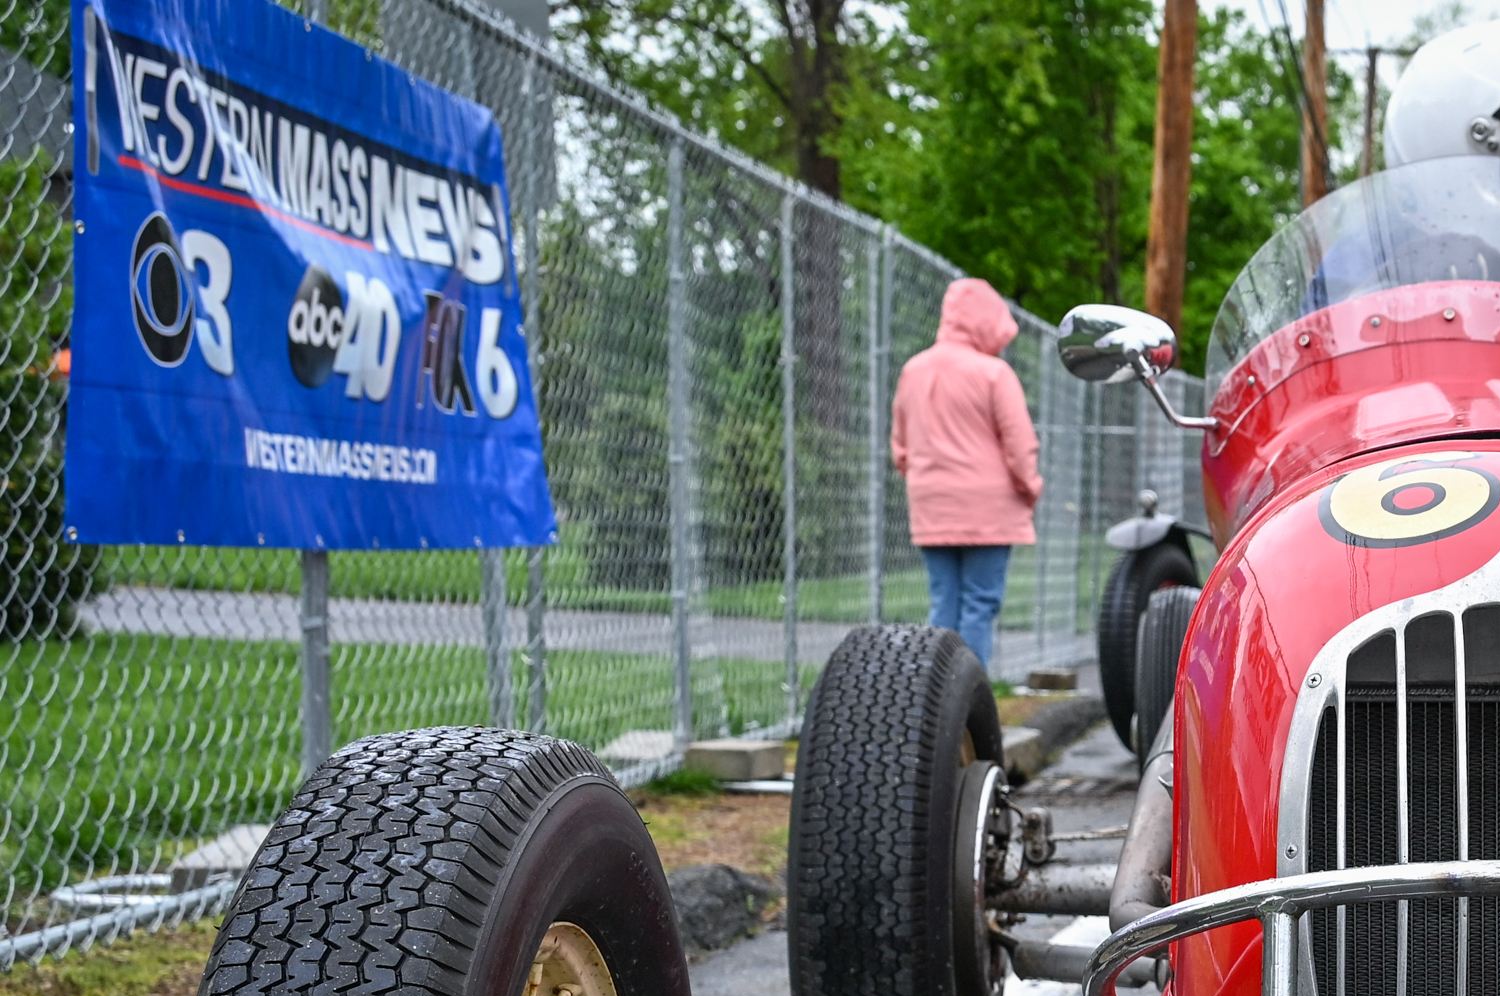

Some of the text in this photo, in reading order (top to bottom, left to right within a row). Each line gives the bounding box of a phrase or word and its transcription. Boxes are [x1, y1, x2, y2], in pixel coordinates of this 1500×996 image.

[278, 117, 369, 239] MASS
[371, 154, 504, 284] NEWS
[181, 229, 234, 376] 3
[288, 288, 344, 350] abc
[333, 270, 400, 401] 40
[477, 308, 518, 419] 6
